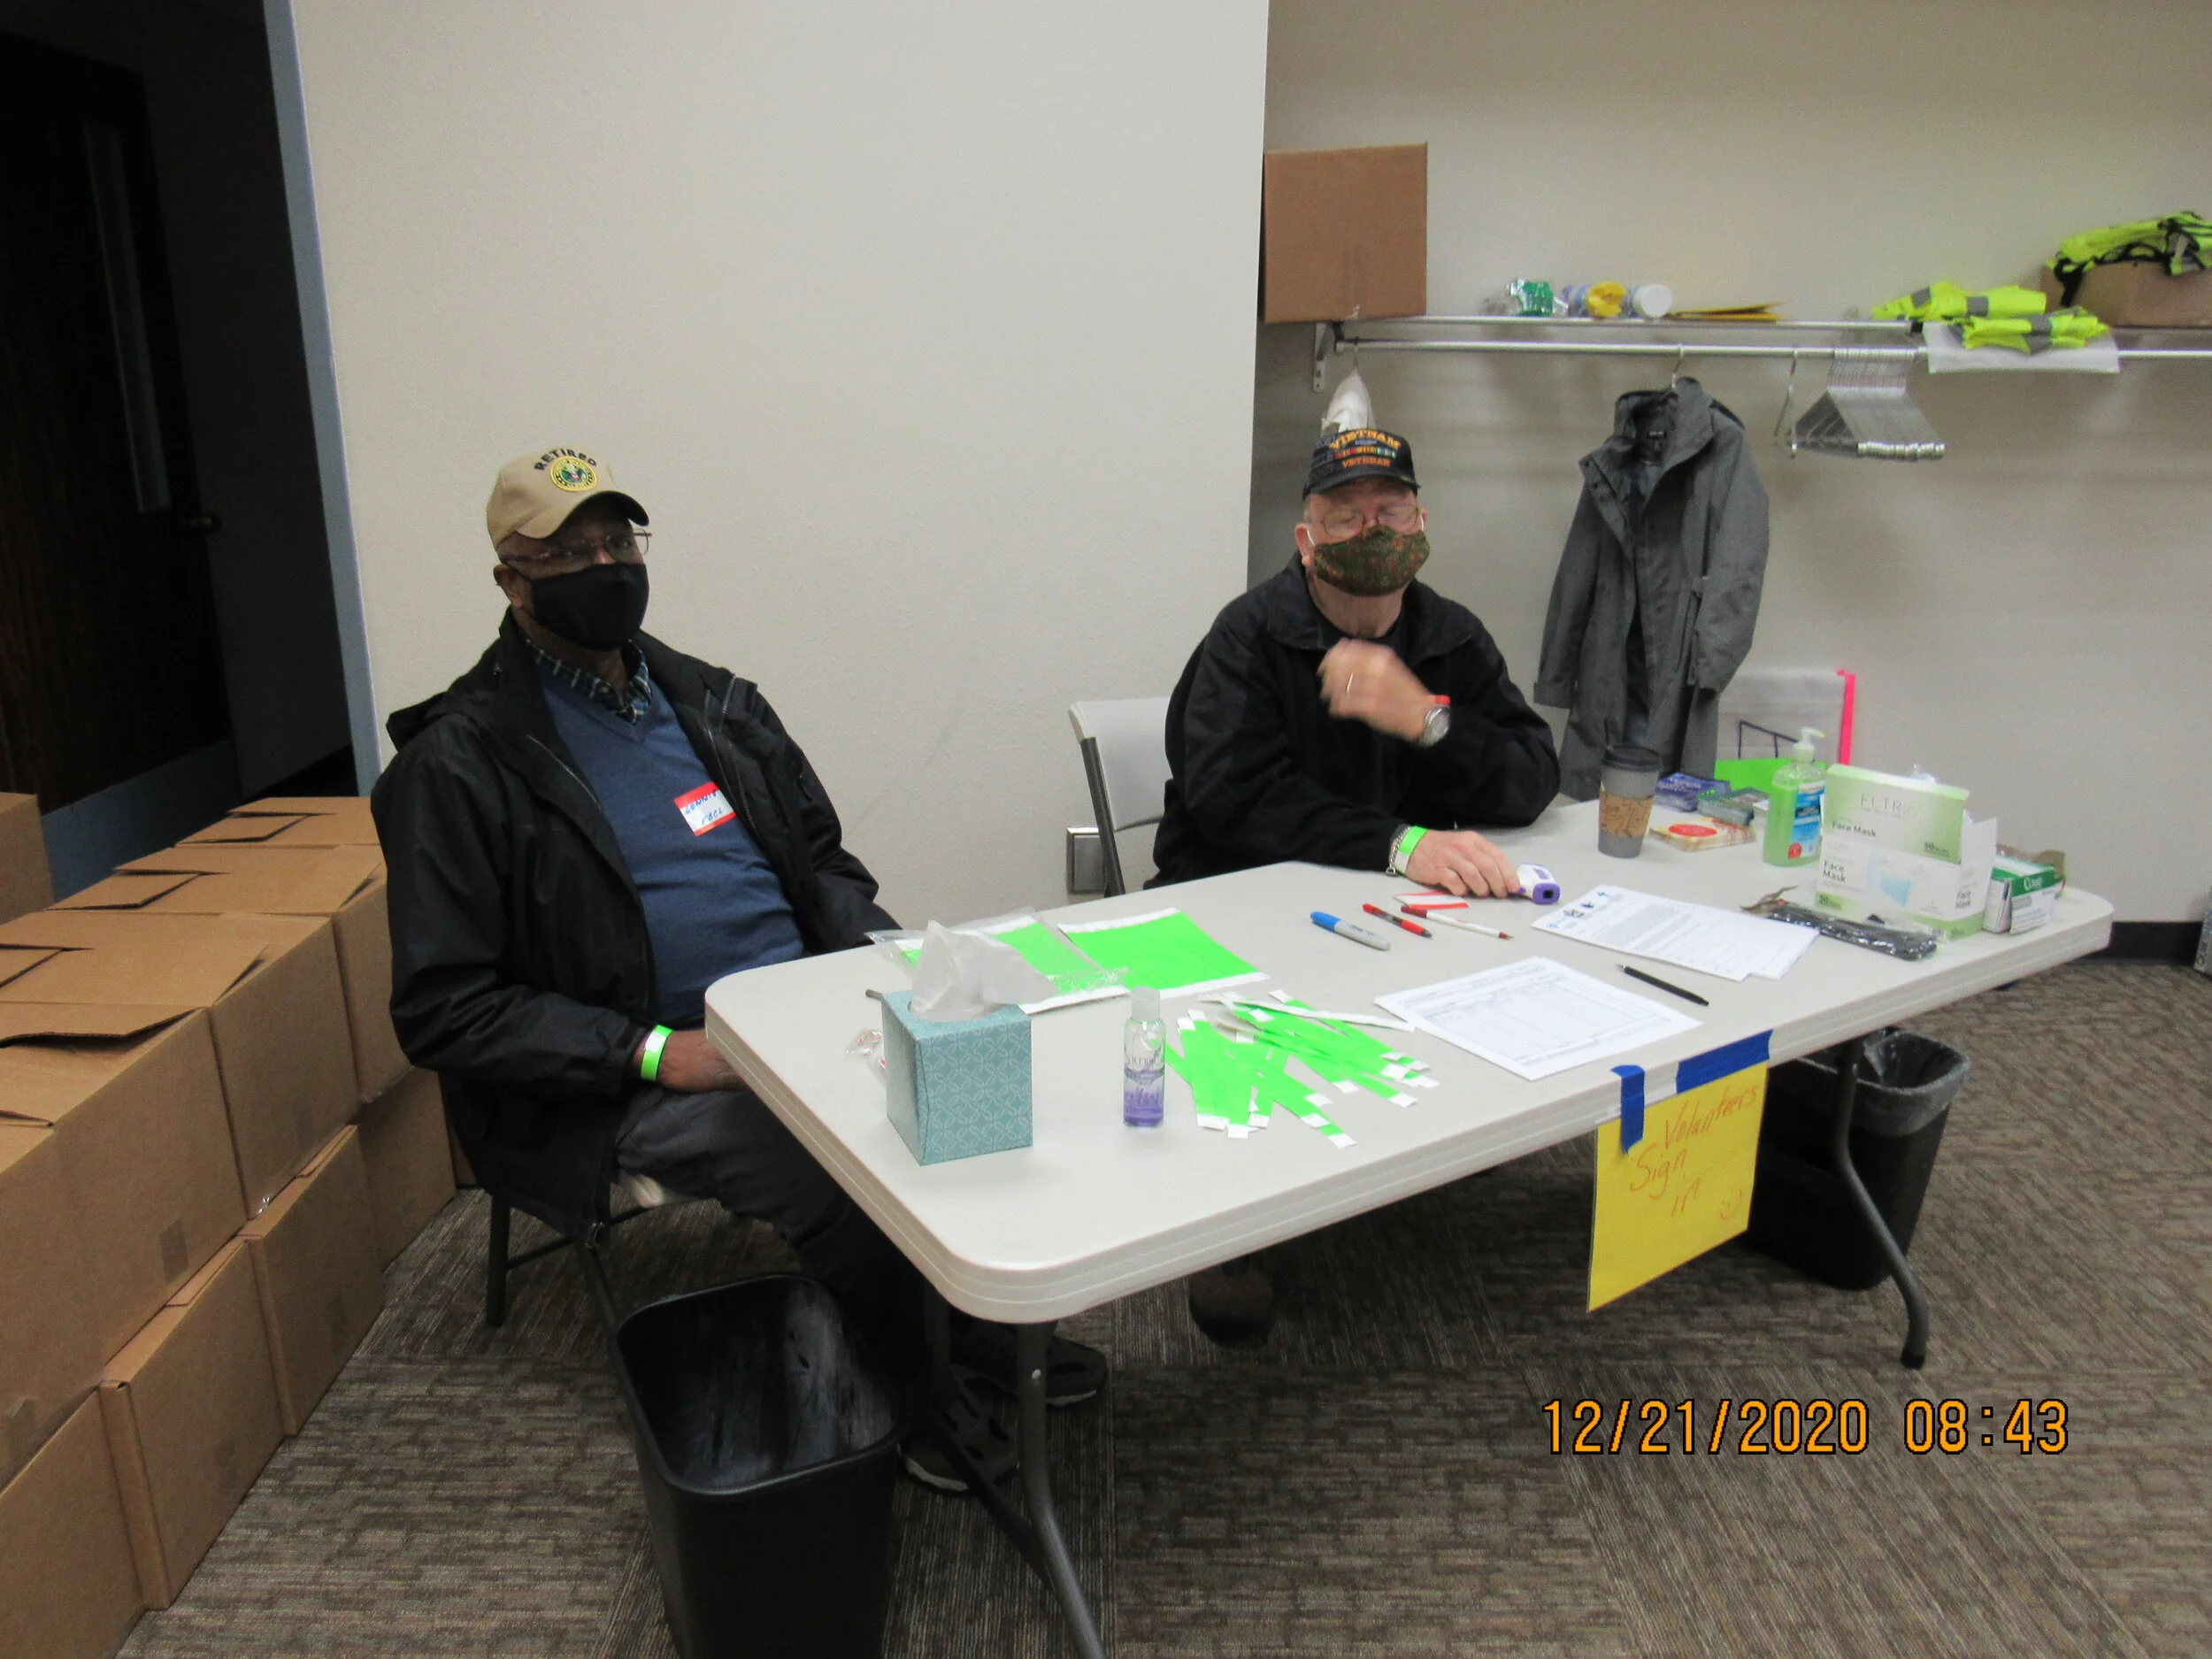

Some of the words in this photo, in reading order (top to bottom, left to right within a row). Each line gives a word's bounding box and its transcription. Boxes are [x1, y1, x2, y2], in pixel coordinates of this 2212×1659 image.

[1329, 429, 1402, 449] VIETNAM
[534, 448, 597, 471] RETIRED
[1341, 456, 1393, 468] VETERAN
[1832, 819, 1852, 833] Face
[1854, 823, 1877, 838] Mask
[1824, 859, 1845, 872] Face
[1823, 869, 1847, 883] Mask
[1664, 1085, 1759, 1150] Volunteers
[1630, 1142, 1688, 1201] Sign
[1670, 1173, 1701, 1217] in
